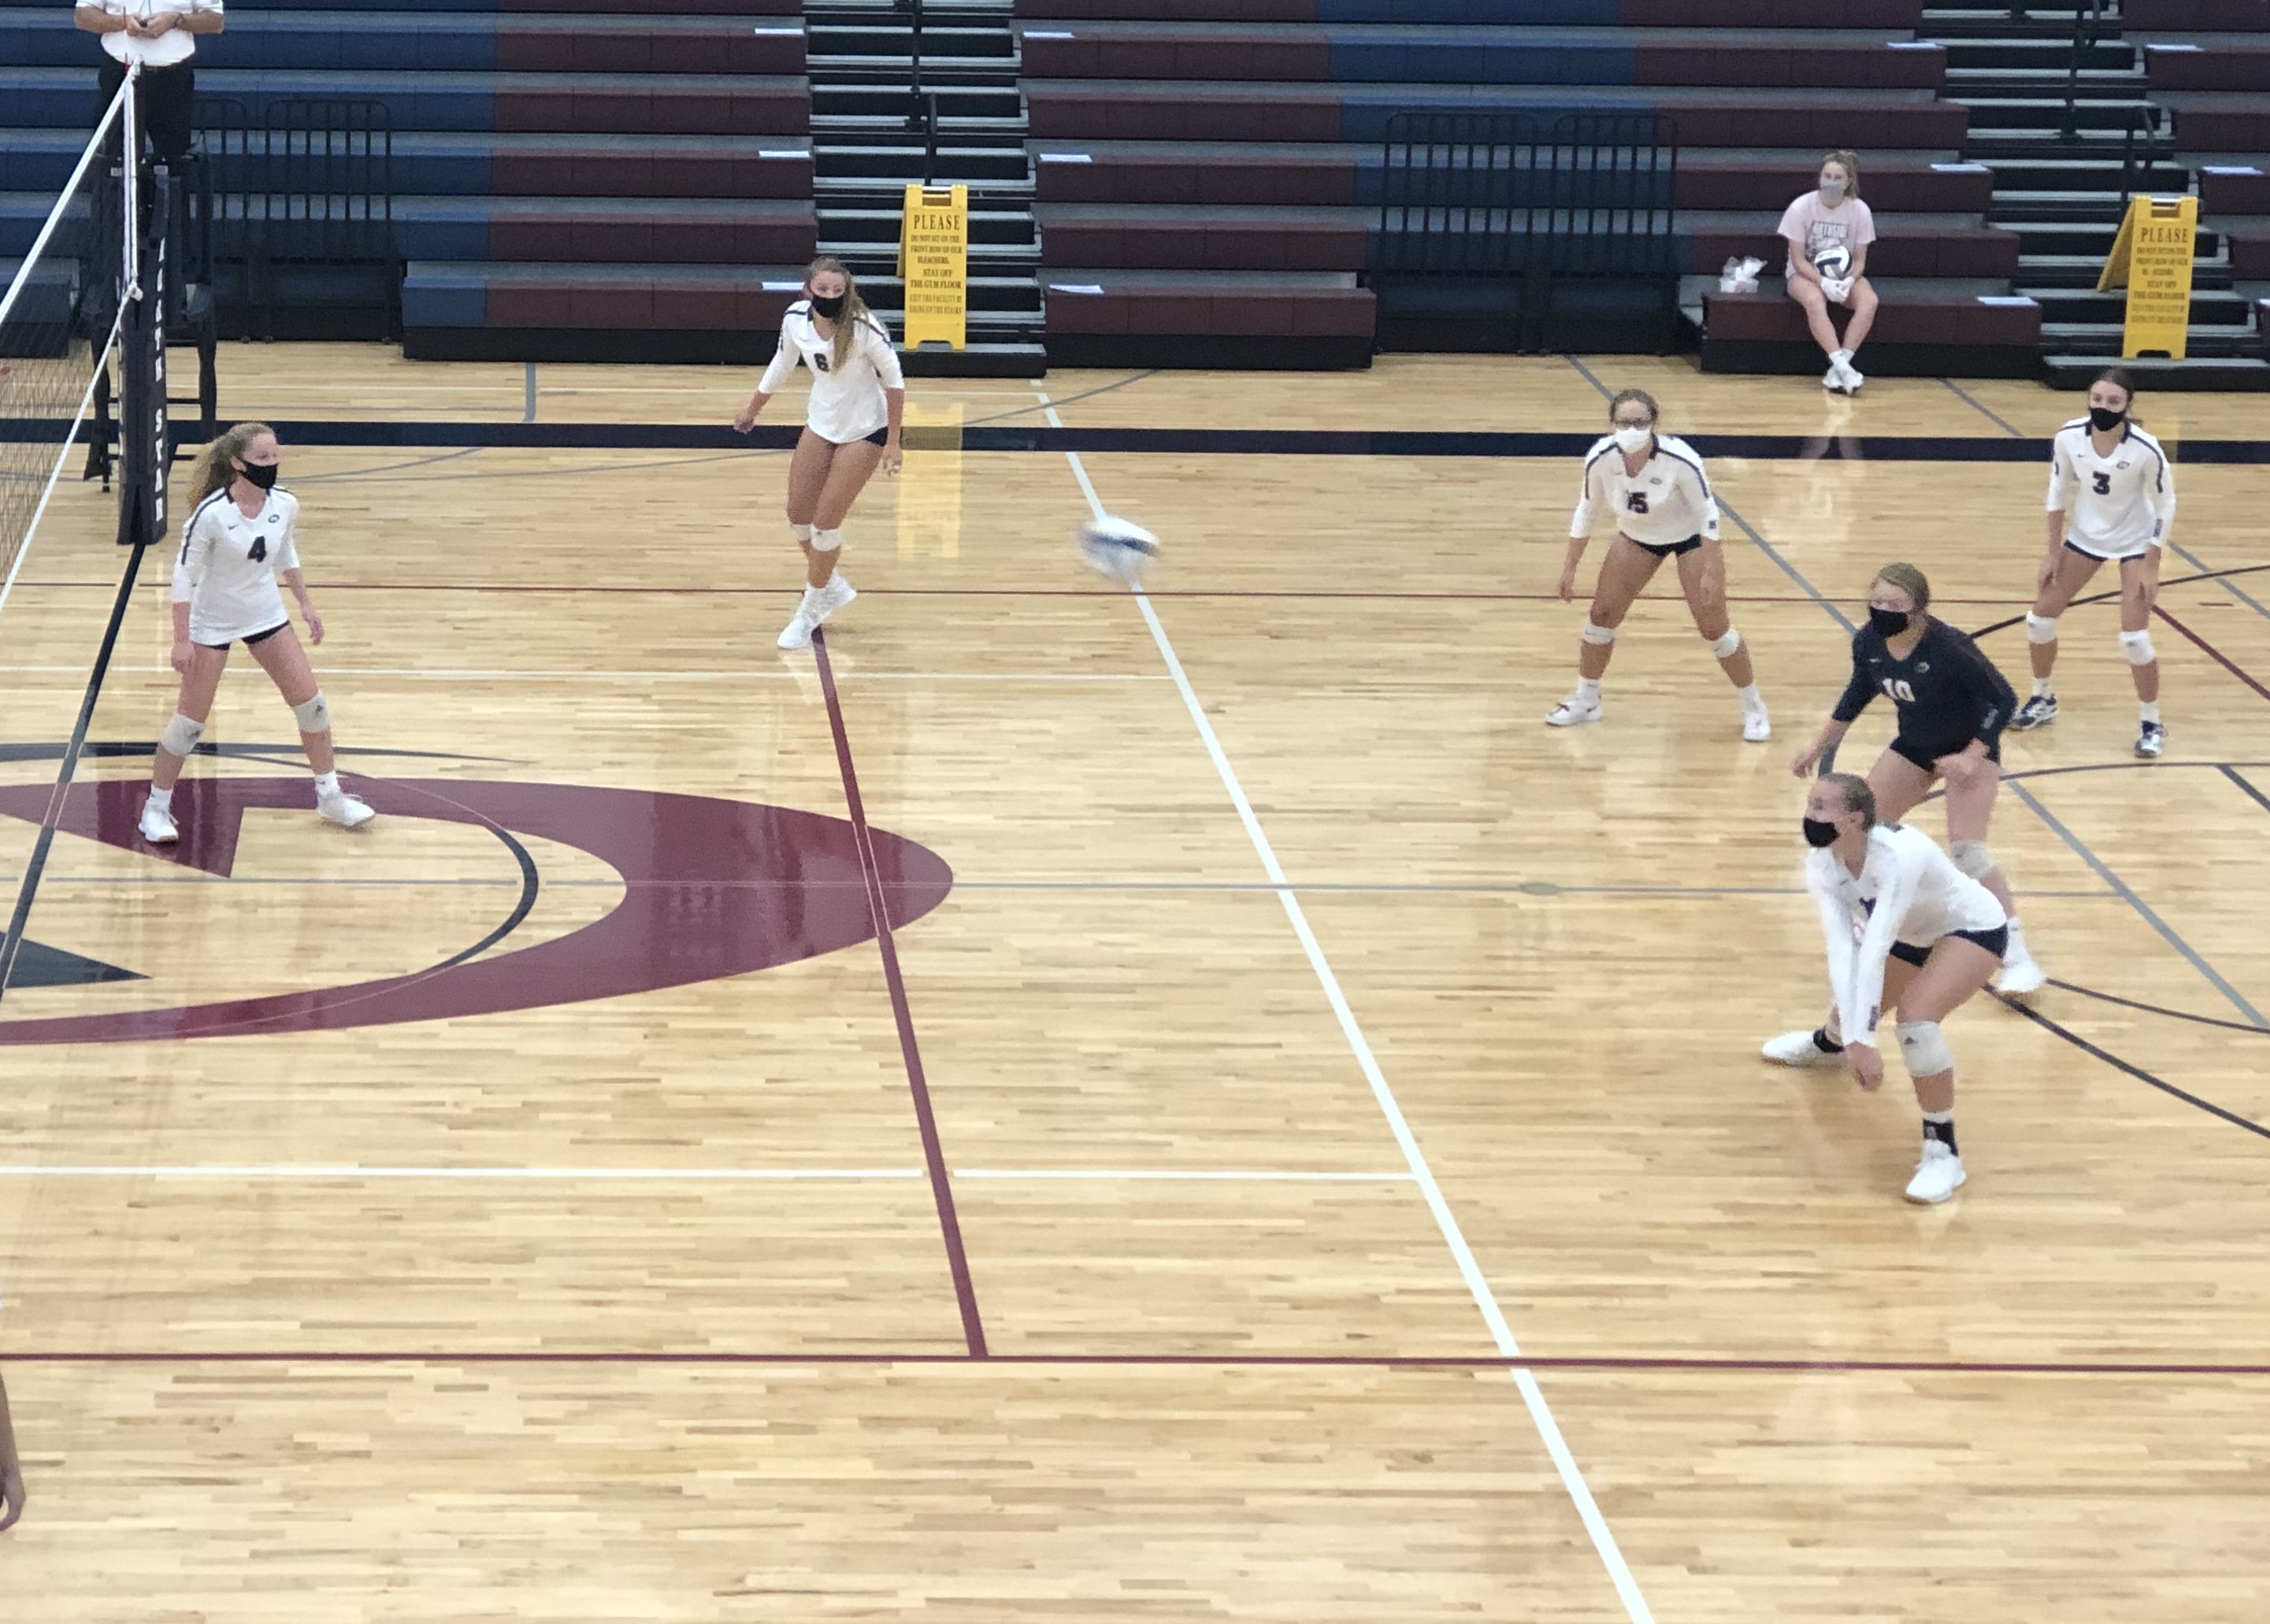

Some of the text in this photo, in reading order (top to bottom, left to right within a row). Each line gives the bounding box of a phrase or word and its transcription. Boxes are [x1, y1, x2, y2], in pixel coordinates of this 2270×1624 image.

[914, 213, 960, 230] PLEASE
[2140, 227, 2188, 243] PLEASE
[940, 269, 952, 277] OFF
[911, 280, 961, 289] THE GYM FLOOR
[814, 353, 830, 373] 6
[2093, 471, 2110, 495] 3
[1626, 489, 1649, 514] 15
[247, 536, 267, 563] 4
[1882, 677, 1916, 703] 10
